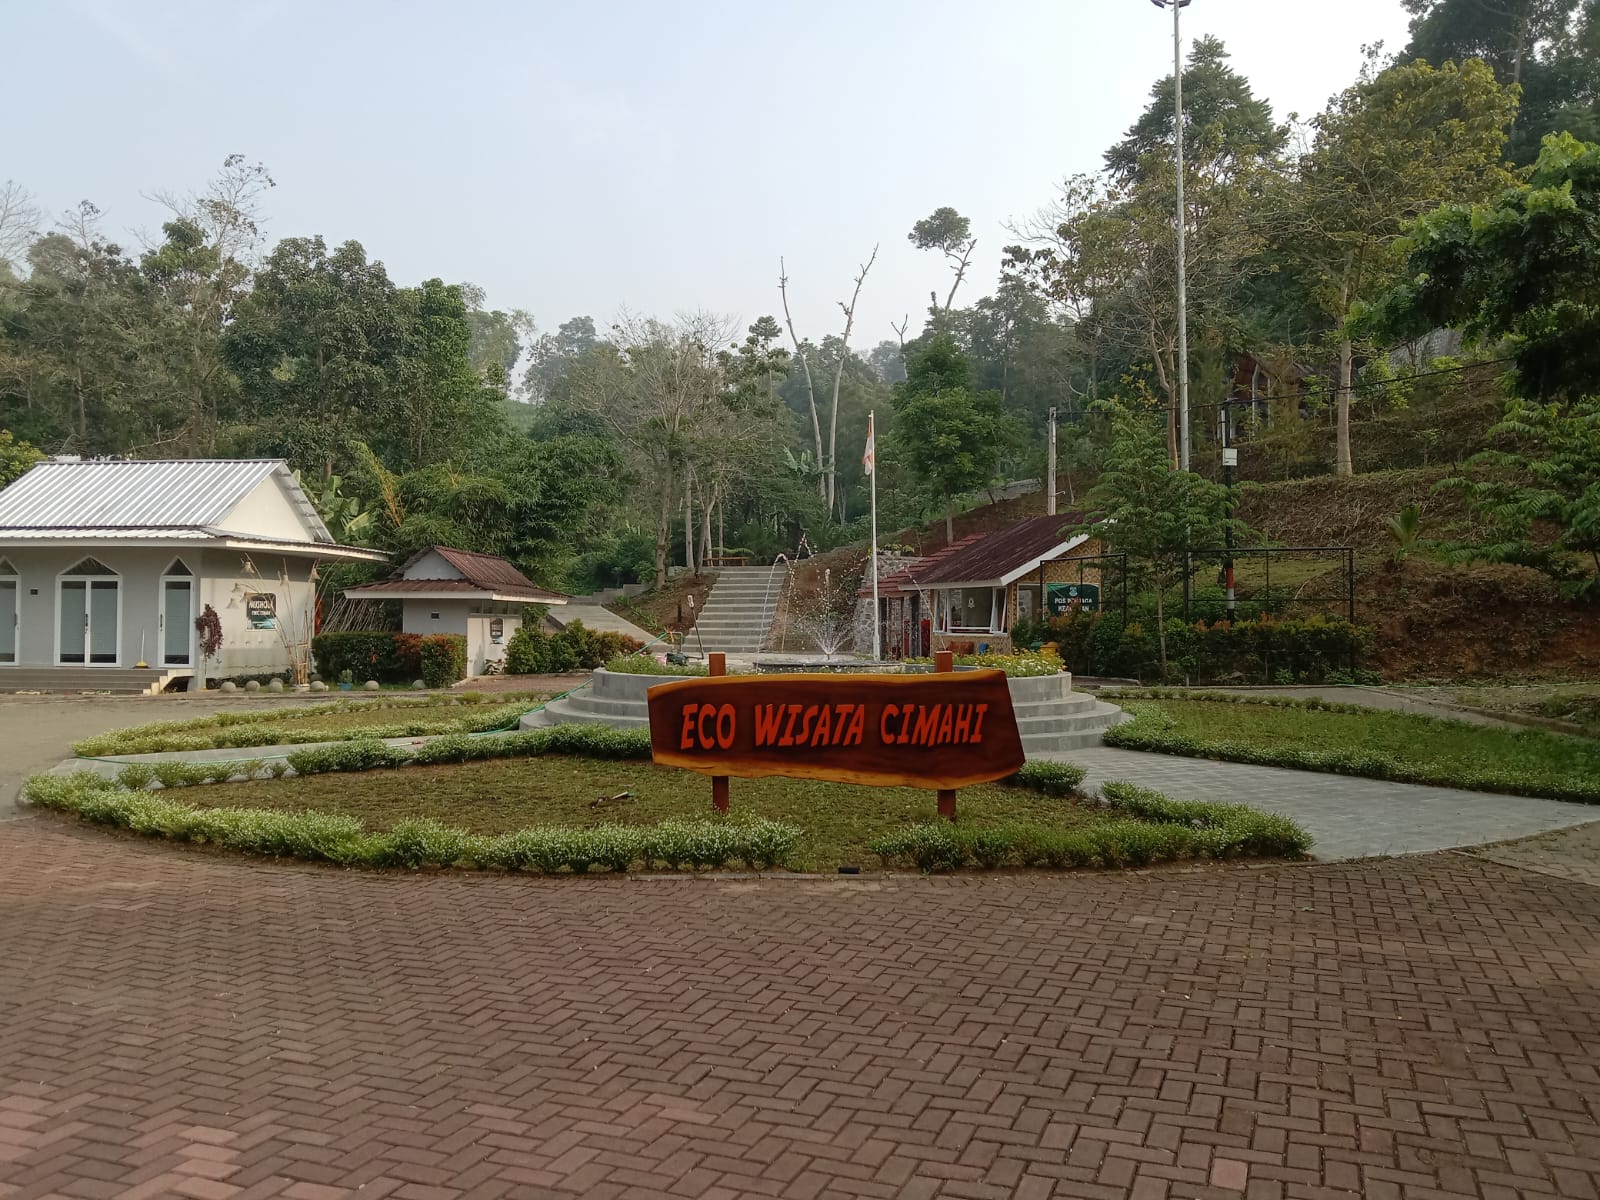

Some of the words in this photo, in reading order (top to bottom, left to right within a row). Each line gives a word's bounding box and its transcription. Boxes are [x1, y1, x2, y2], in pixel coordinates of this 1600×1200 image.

[681, 703, 736, 750] ECO
[754, 703, 865, 747] WISATA
[880, 703, 988, 747] CIMAHI
